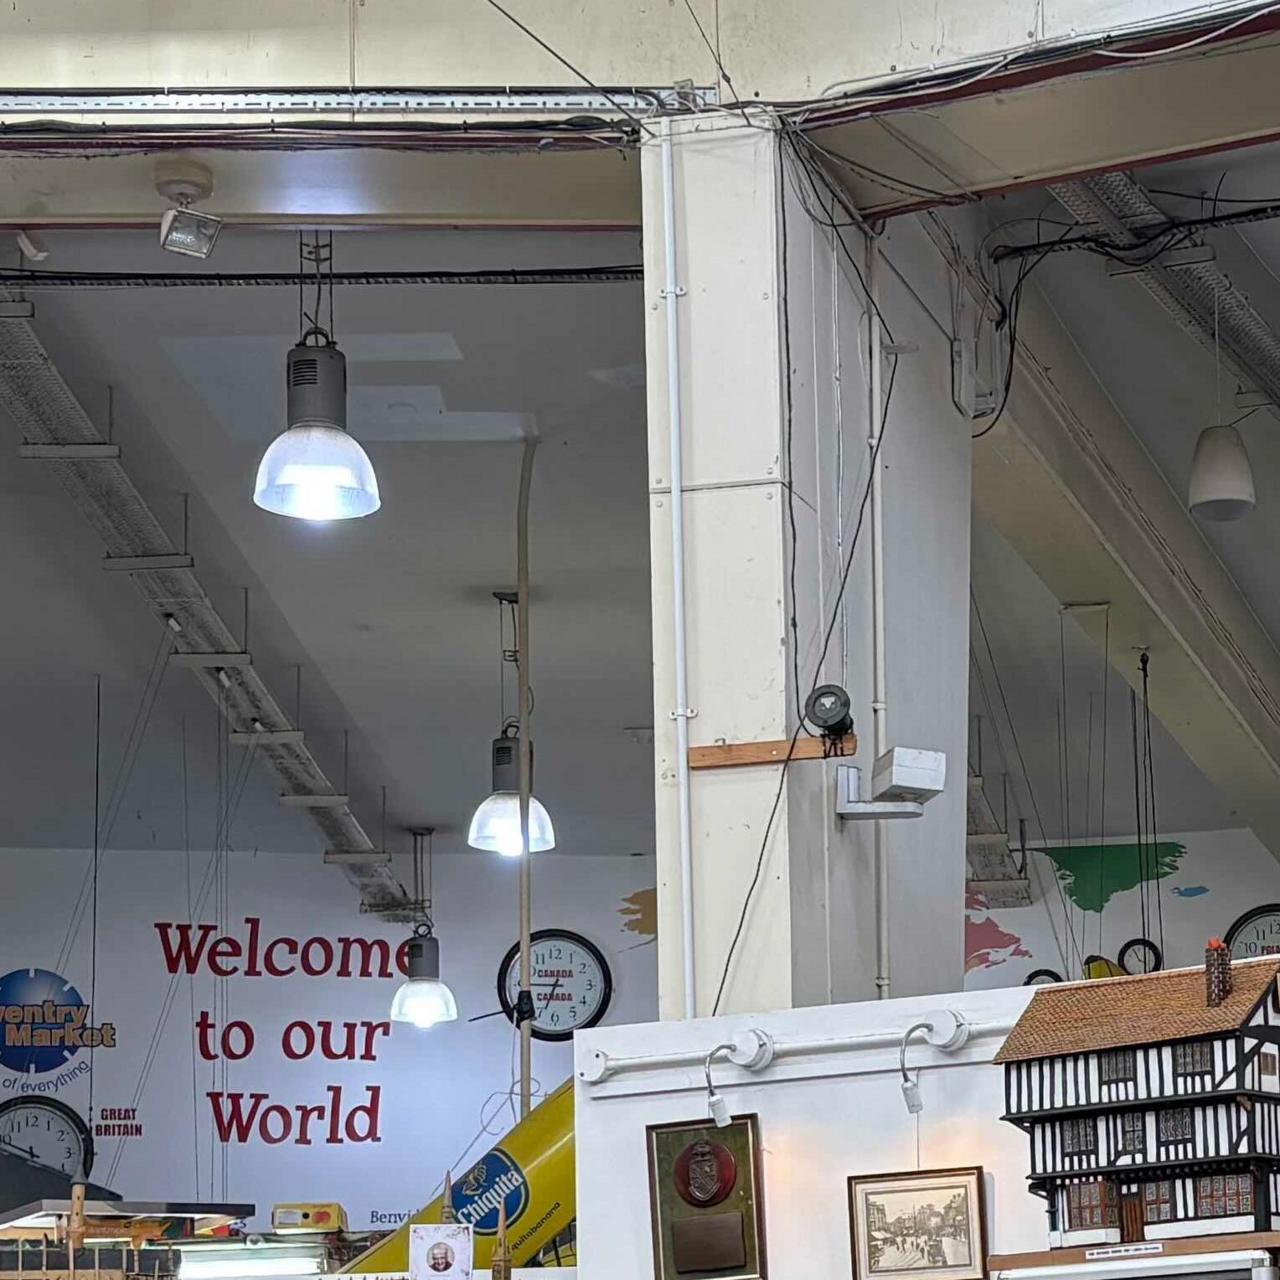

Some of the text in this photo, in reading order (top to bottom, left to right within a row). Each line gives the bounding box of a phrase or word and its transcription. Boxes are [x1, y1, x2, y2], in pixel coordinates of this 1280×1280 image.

[537, 969, 574, 978] CANADA
[536, 992, 573, 1001] CANADA
[5, 1022, 117, 1048] Market
[196, 1011, 391, 1062] to our
[2, 1077, 19, 1091] of
[20, 1060, 92, 1093] everything
[100, 1108, 137, 1121] GREAT
[207, 1085, 382, 1146] World
[95, 1124, 143, 1137] BRITAIN
[456, 1167, 524, 1226] Chiquita
